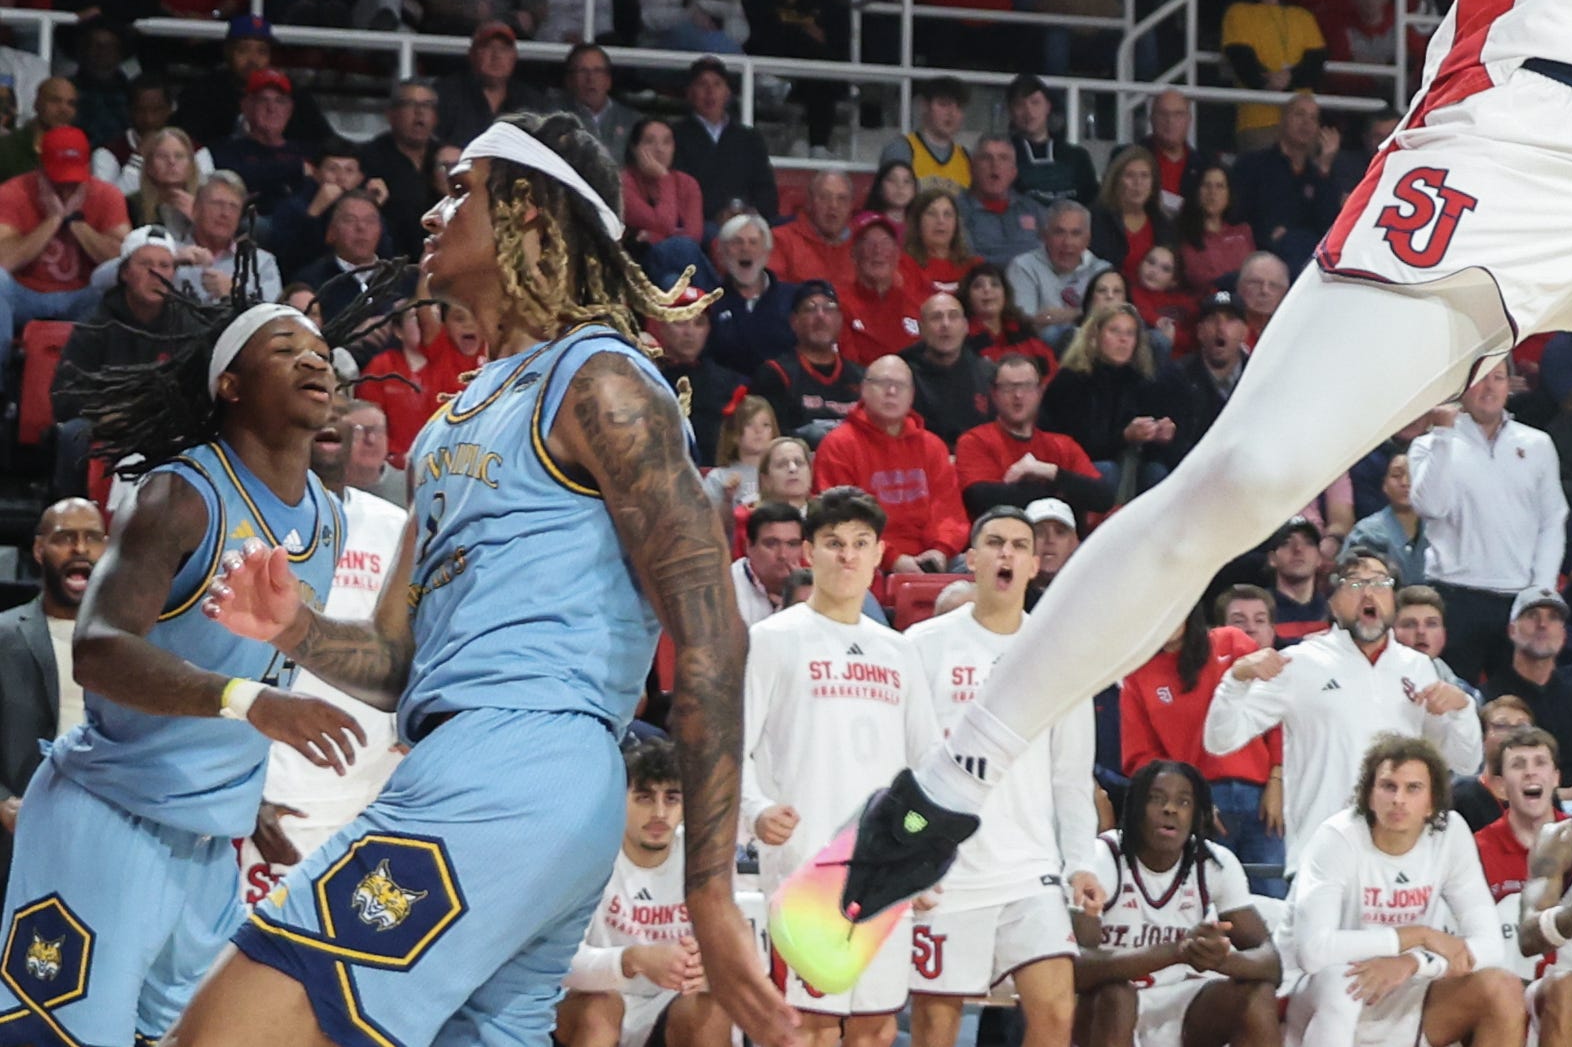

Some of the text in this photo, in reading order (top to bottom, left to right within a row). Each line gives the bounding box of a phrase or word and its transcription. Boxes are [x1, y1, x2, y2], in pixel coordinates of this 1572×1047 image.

[1374, 167, 1478, 268] SJ
[809, 661, 900, 689] ST. JOHN'S
[951, 666, 979, 686] ST.
[912, 926, 947, 979] SJ
